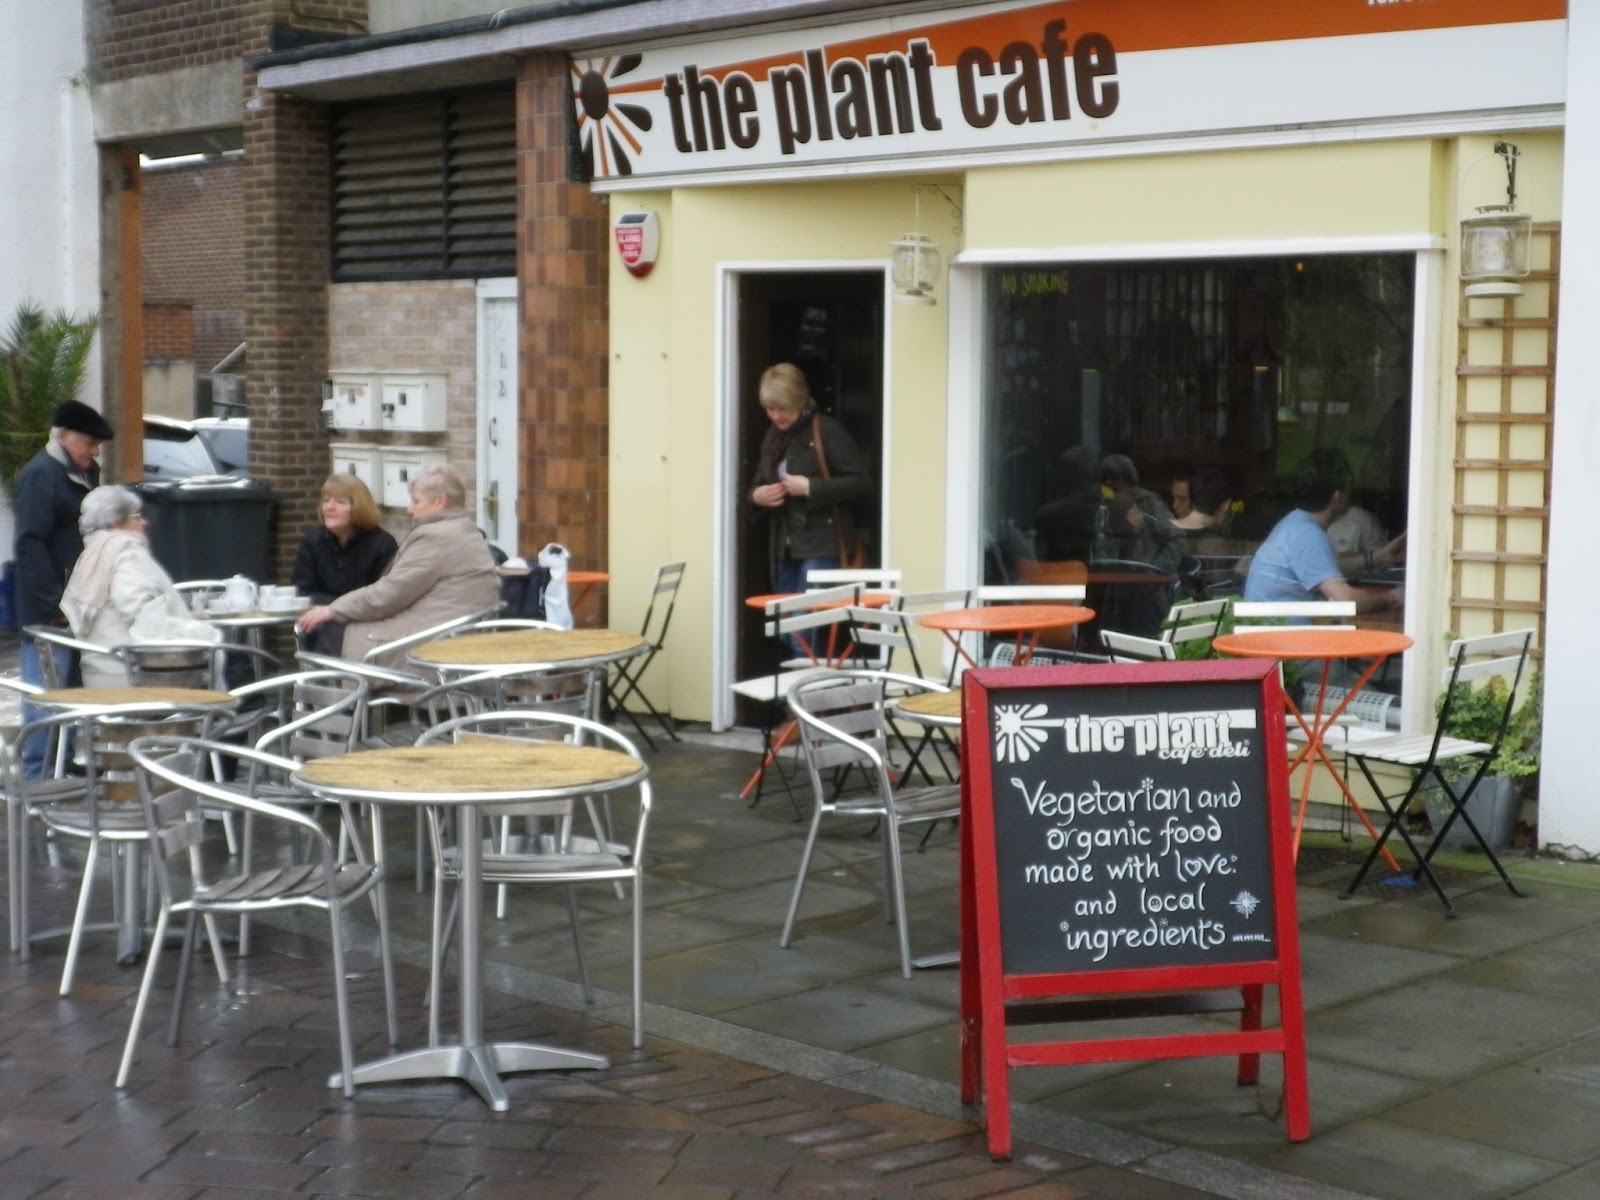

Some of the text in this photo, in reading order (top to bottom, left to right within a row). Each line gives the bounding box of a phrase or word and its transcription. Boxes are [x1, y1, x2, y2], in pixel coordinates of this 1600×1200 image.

[663, 18, 1120, 154] the plant cafe
[1063, 712, 1231, 756] the plant
[1010, 777, 1242, 826] Vegetarian and
[1047, 815, 1223, 860] organic food
[1025, 856, 1094, 884] made
[1106, 854, 1160, 883] with
[1074, 882, 1206, 916] and local
[1059, 917, 1226, 962] ingredients
